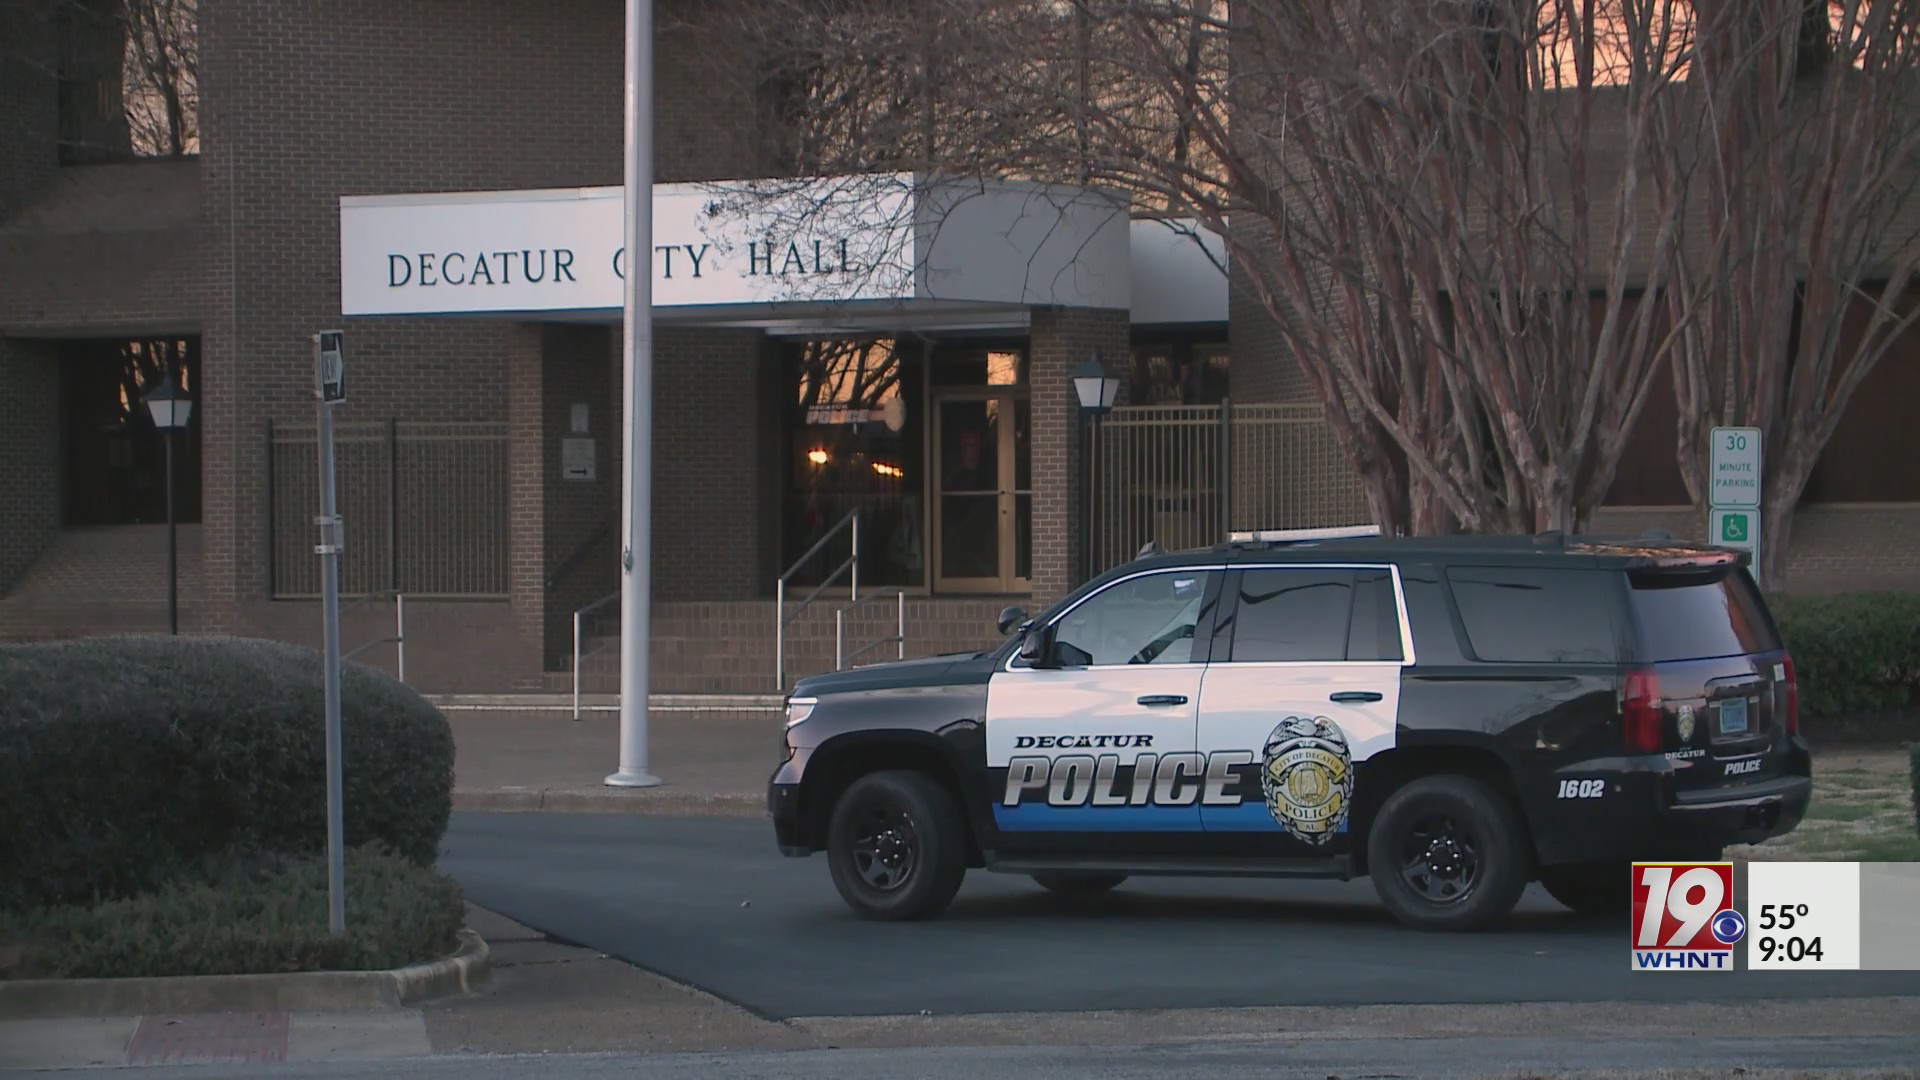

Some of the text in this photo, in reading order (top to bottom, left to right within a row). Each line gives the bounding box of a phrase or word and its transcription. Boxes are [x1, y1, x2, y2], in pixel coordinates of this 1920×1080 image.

[388, 238, 863, 288] DECATUR CTY HALL
[1726, 436, 1746, 450] 30
[1719, 463, 1752, 472] MINUTE
[1716, 479, 1755, 488] PARKING
[1015, 735, 1154, 748] DECATUR
[1275, 757, 1291, 772] CITY
[1292, 752, 1302, 760] OF
[1665, 749, 1706, 760] DECATUR
[1724, 759, 1762, 775] POLICE
[1003, 751, 1254, 807] POLICE
[1557, 779, 1605, 798] 1602
[1285, 801, 1335, 819] POLICE
